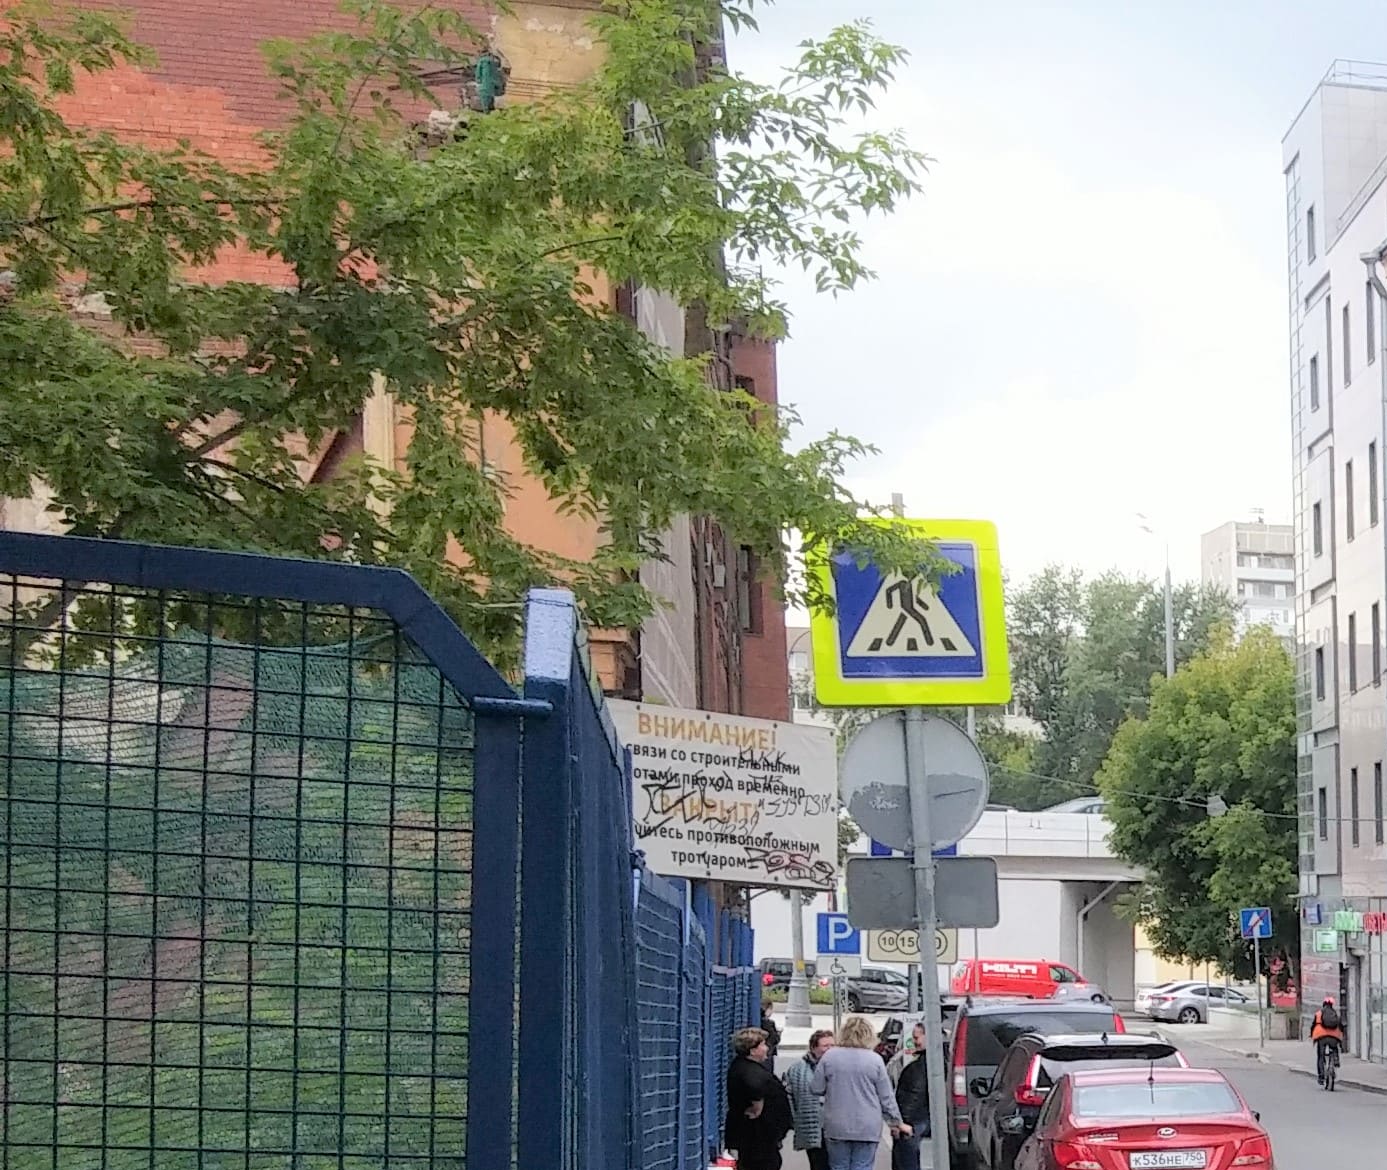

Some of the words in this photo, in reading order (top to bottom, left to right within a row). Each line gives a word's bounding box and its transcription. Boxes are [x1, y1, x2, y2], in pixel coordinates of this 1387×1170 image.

[638, 712, 776, 751] ВНИМАНИЕ!
[671, 749, 687, 761] со
[737, 779, 806, 799] временно
[687, 829, 821, 853] противоположным
[671, 851, 747, 870] тротуаром
[881, 936, 895, 947] 10
[900, 936, 915, 948] 15
